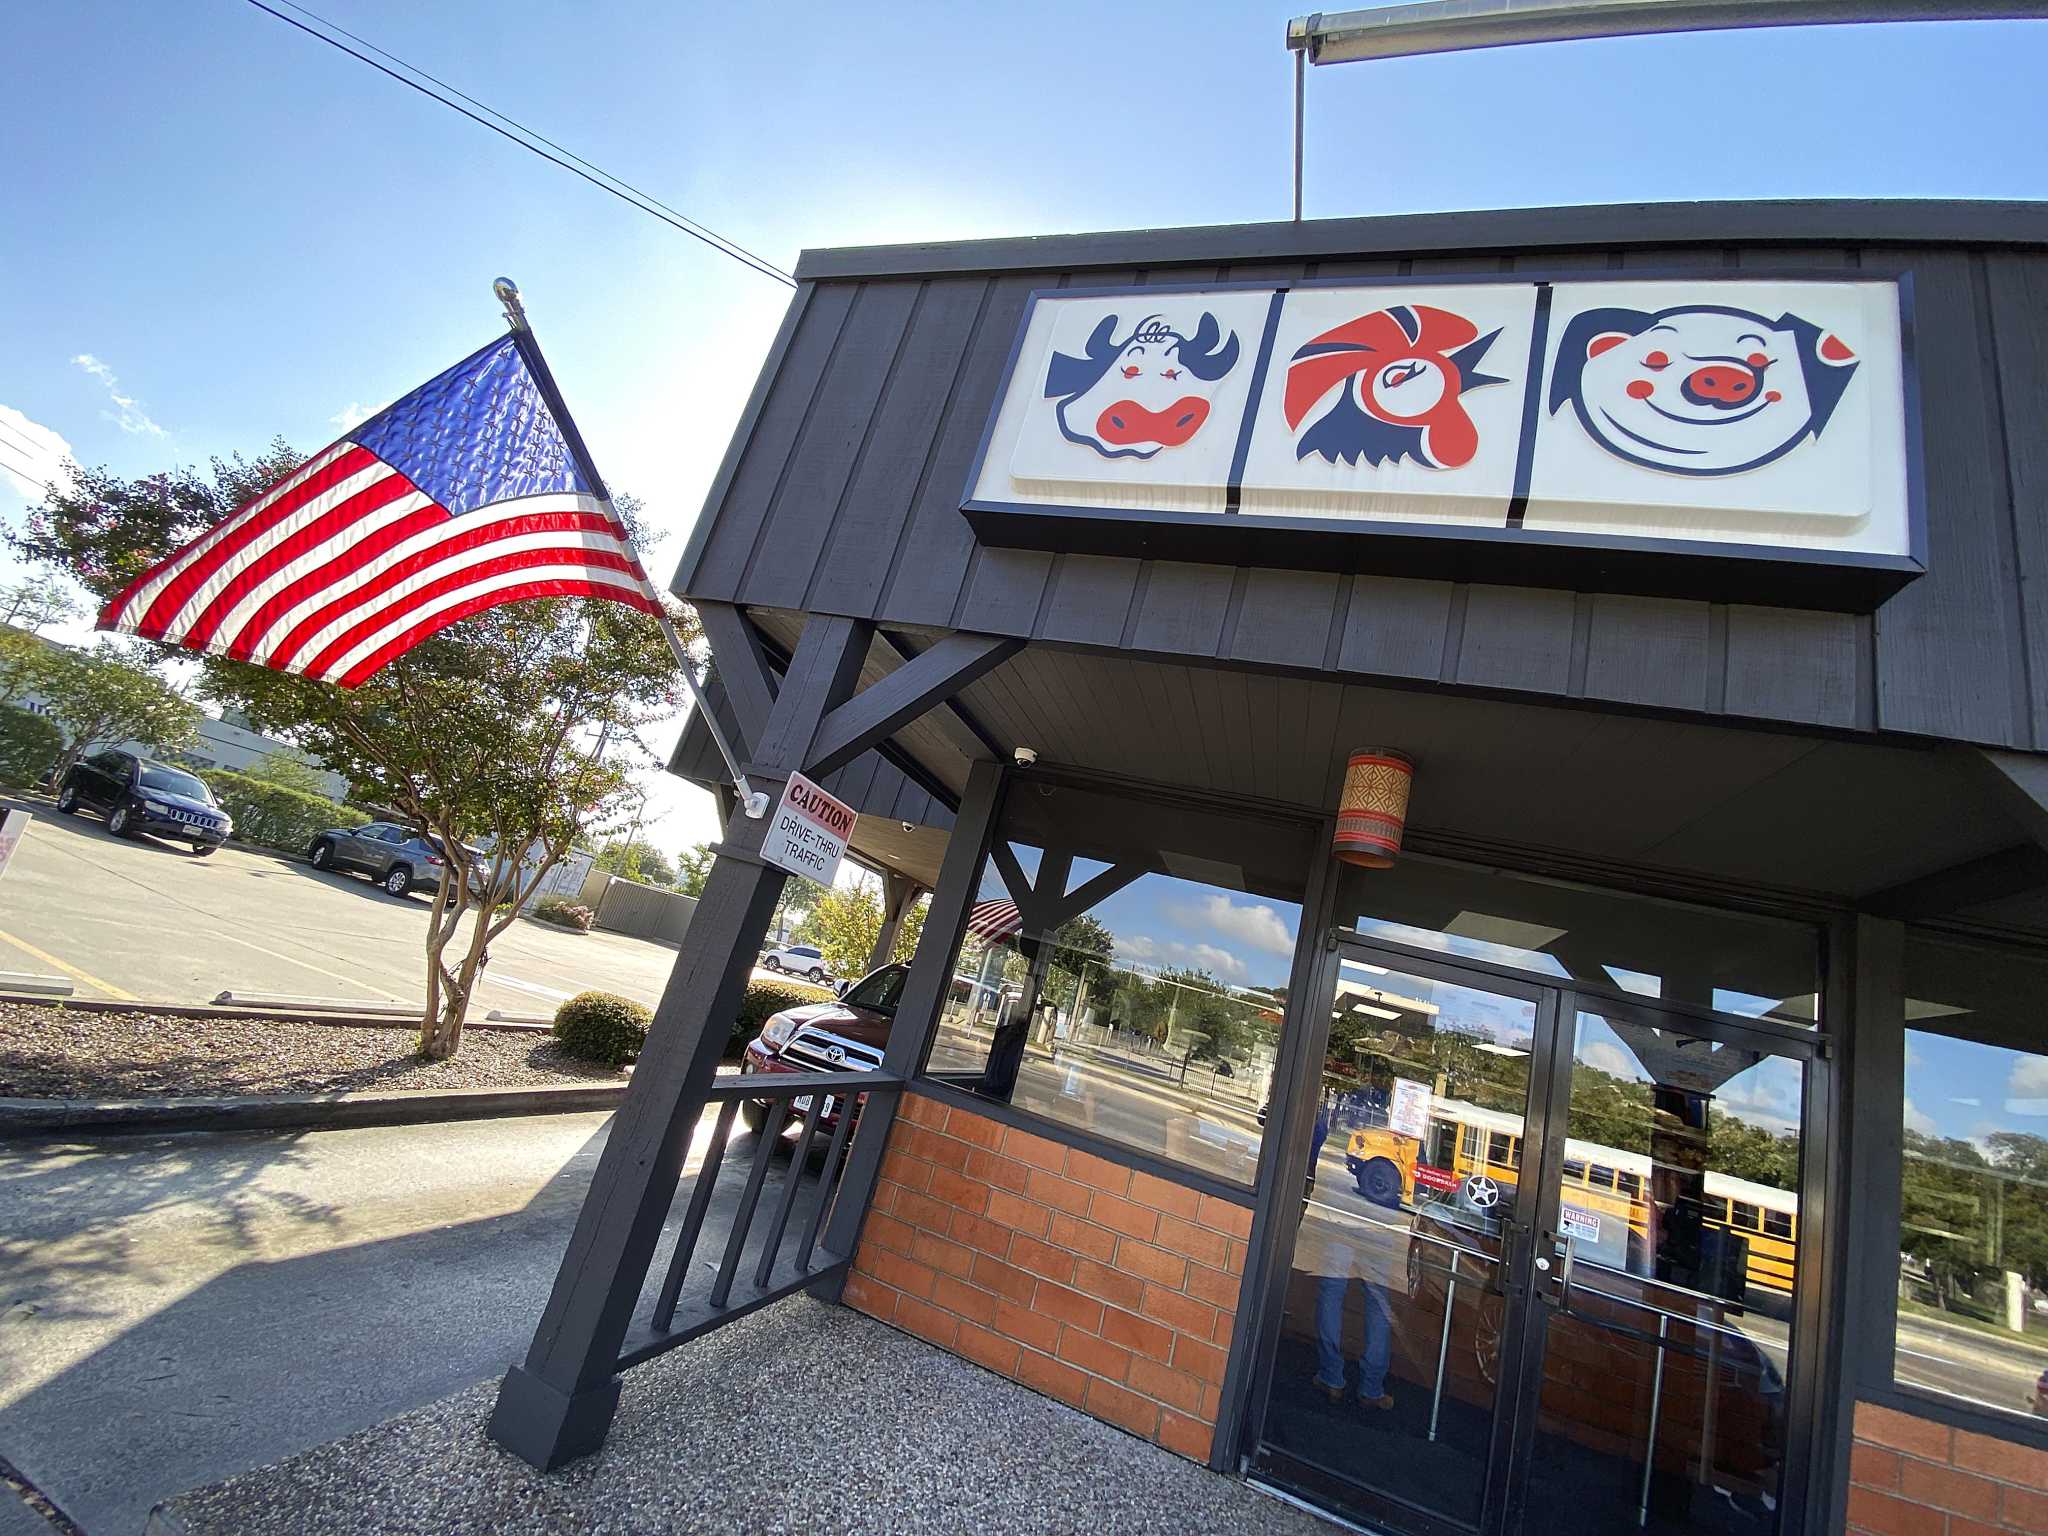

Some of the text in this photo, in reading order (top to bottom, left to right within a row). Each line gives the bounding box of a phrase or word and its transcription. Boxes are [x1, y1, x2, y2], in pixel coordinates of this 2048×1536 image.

[790, 784, 852, 833] CAUTION
[780, 816, 840, 859] DRIVE-THRU
[785, 840, 825, 871] TRAFFIC
[1564, 1210, 1598, 1227] WARNING
